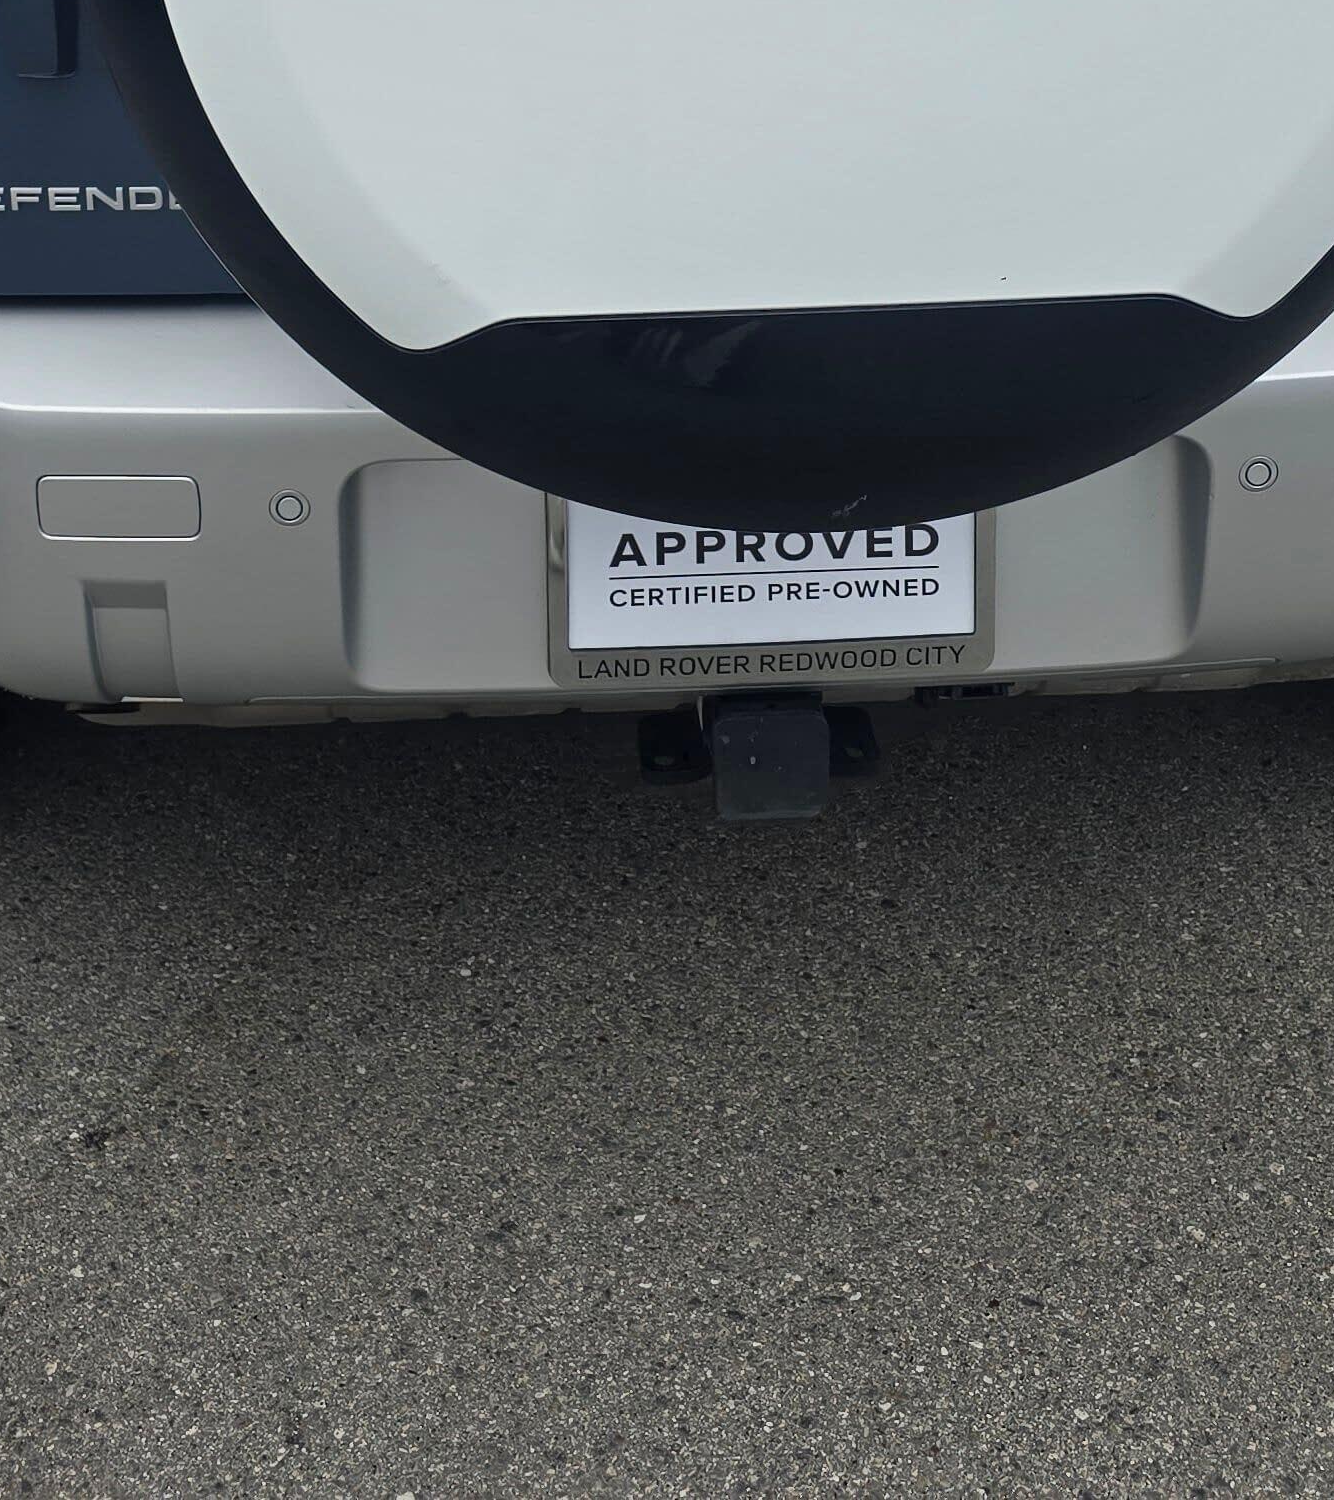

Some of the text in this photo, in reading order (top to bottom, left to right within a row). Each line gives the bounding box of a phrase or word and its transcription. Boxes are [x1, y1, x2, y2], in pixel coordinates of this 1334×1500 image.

[609, 523, 940, 568] APPROVED
[609, 578, 940, 607] CERTIFIED PRE-OWNED
[578, 644, 967, 679] LAND ROVER REDWOOD CITY
